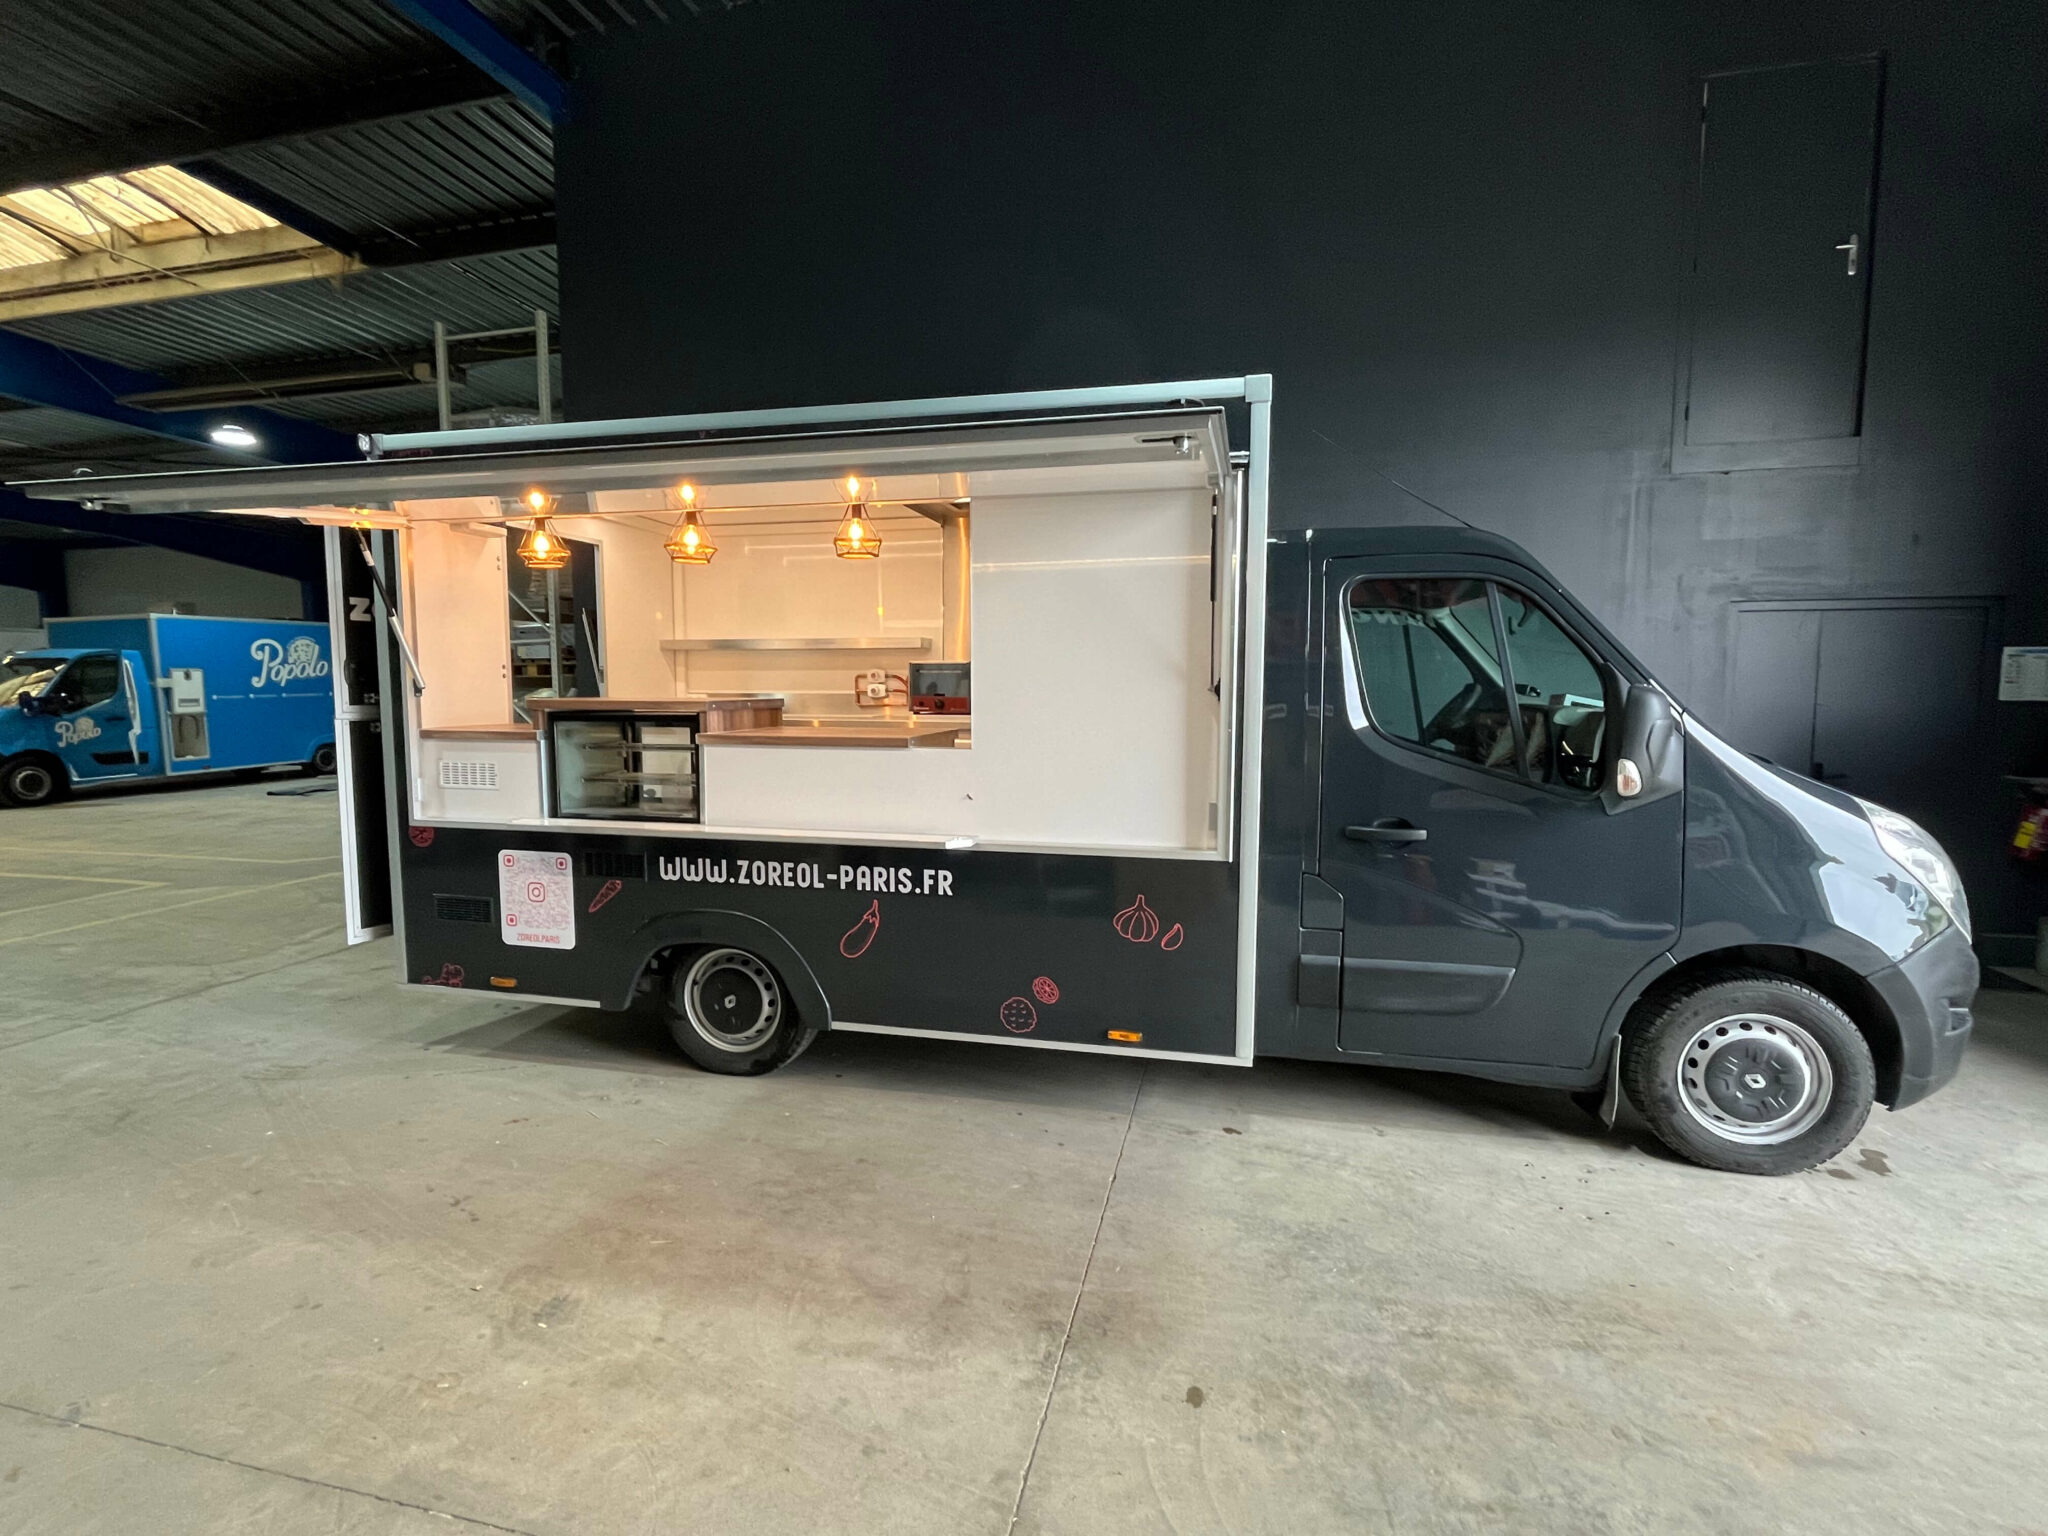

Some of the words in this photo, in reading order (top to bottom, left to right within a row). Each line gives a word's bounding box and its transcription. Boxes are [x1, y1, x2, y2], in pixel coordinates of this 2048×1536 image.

[348, 596, 374, 622] Z
[250, 638, 329, 688] Popolo
[658, 856, 954, 897] WWW.ZOREOL-PARIS.FR
